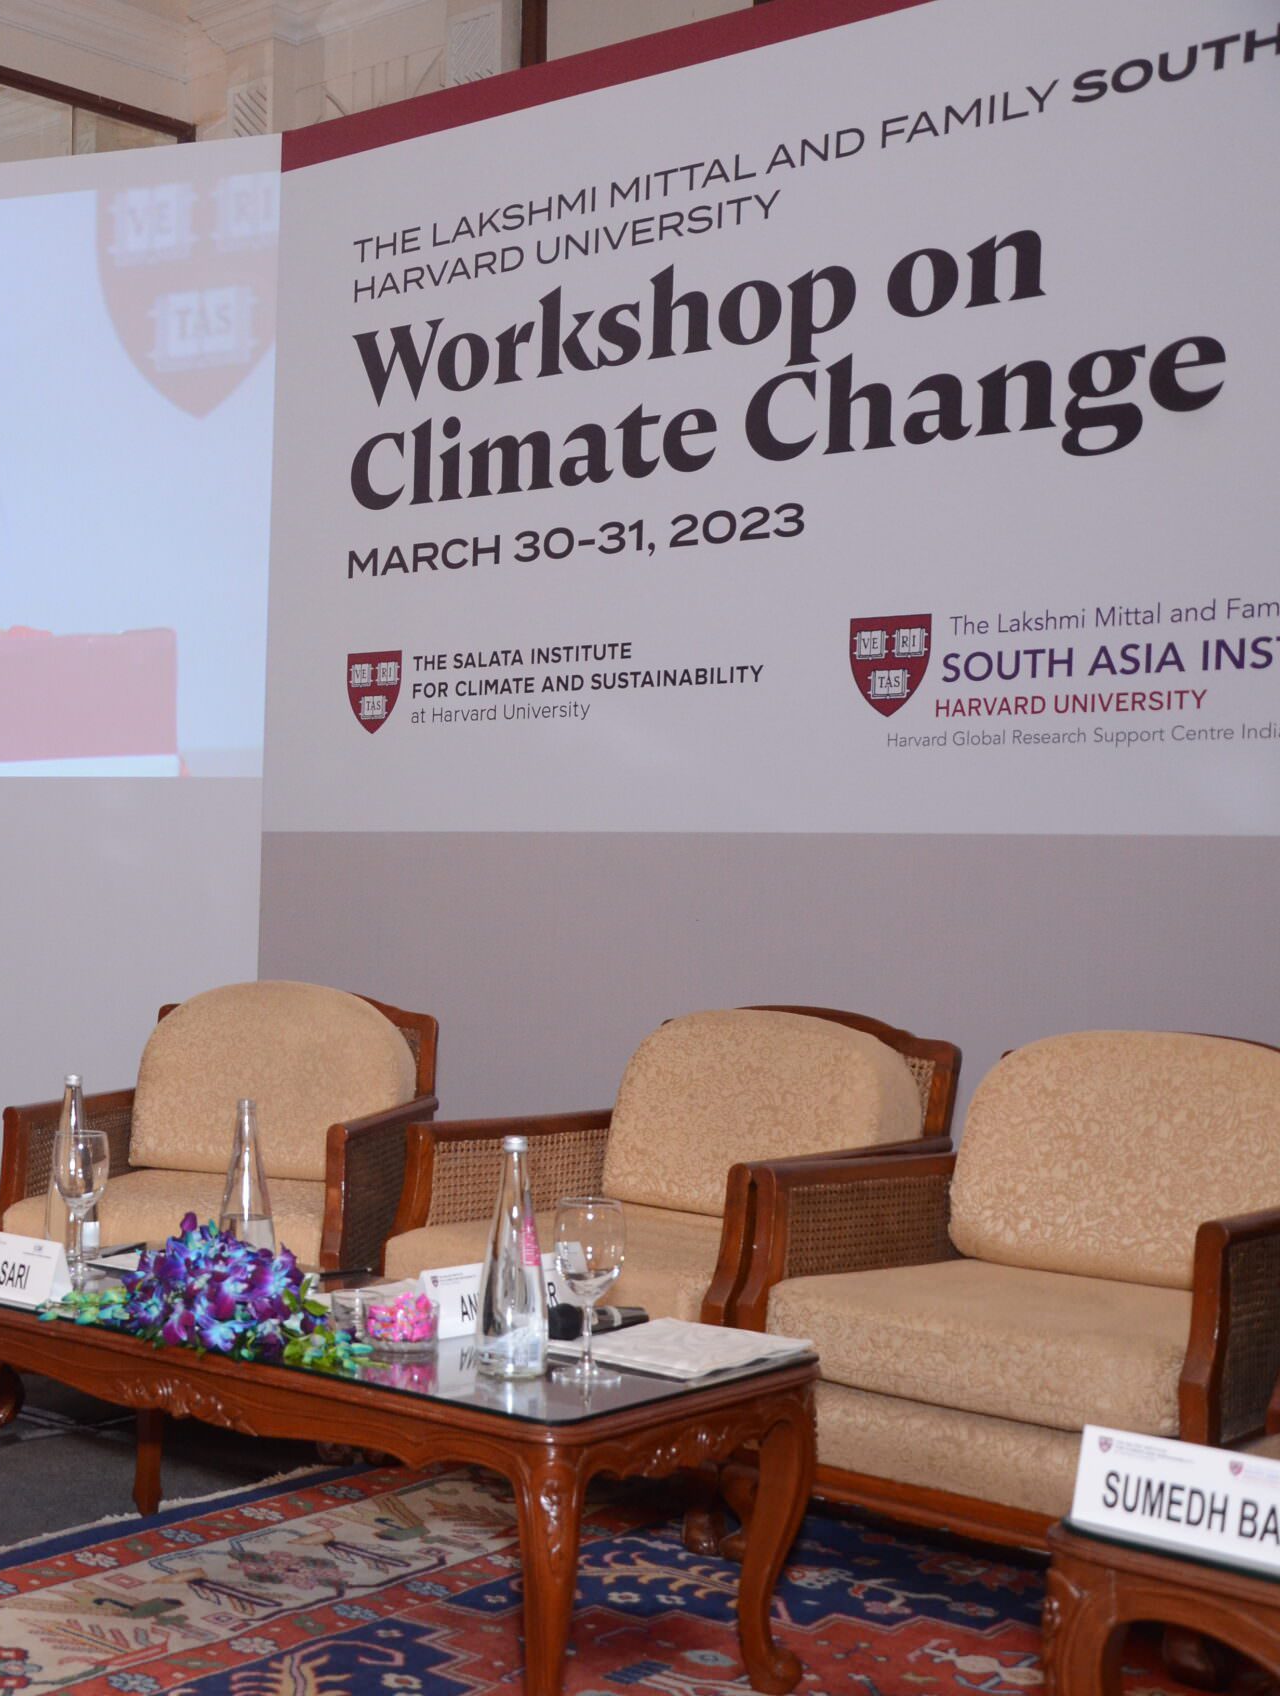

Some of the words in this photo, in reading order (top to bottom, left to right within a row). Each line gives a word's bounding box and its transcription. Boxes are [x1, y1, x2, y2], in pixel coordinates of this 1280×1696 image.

[354, 227, 420, 263] THE
[433, 187, 596, 247] LAKSHMI
[610, 154, 756, 208] MITTAL
[766, 127, 865, 174] AND
[881, 80, 1059, 149] FAMILY
[1072, 21, 1280, 103] SOUTH
[354, 246, 524, 302] HARVARD
[537, 190, 781, 265] UNIVERSITY
[352, 263, 857, 407] Workshop
[887, 229, 1046, 318] on
[350, 403, 718, 511] Climate
[744, 335, 1228, 461] Change
[346, 534, 501, 578] MARCH
[513, 519, 657, 563] 30-31,
[670, 503, 805, 546] 2023
[950, 615, 989, 636] The
[998, 609, 1086, 633] Lakshmi
[1095, 603, 1161, 627] Mittal
[1170, 598, 1216, 624] and
[413, 655, 447, 671] THE
[453, 649, 523, 669] SALATA
[531, 642, 632, 665] INSTITUTE
[862, 638, 878, 649] VE
[902, 635, 916, 648] RI
[942, 648, 1074, 682] SOUTH
[1088, 642, 1185, 676] ASIA
[1202, 636, 1280, 670] INS
[412, 682, 448, 699] FOR
[455, 677, 535, 697] CLIMATE
[541, 674, 584, 693] AND
[590, 665, 764, 690] SUSTAINABILITY
[878, 676, 900, 688] TAS
[411, 708, 425, 724] at
[432, 703, 497, 722] Harvard
[503, 701, 590, 721] University
[935, 695, 1046, 718] HARVARD
[1054, 689, 1207, 714] UNIVERSITY
[887, 731, 947, 748] Harvard
[952, 730, 1006, 747] Global
[1012, 728, 1087, 745] Research
[1094, 726, 1165, 747] Support
[1171, 724, 1234, 742] Centre
[1102, 1469, 1229, 1533] SUMEDH
[1238, 1500, 1280, 1546] BA
